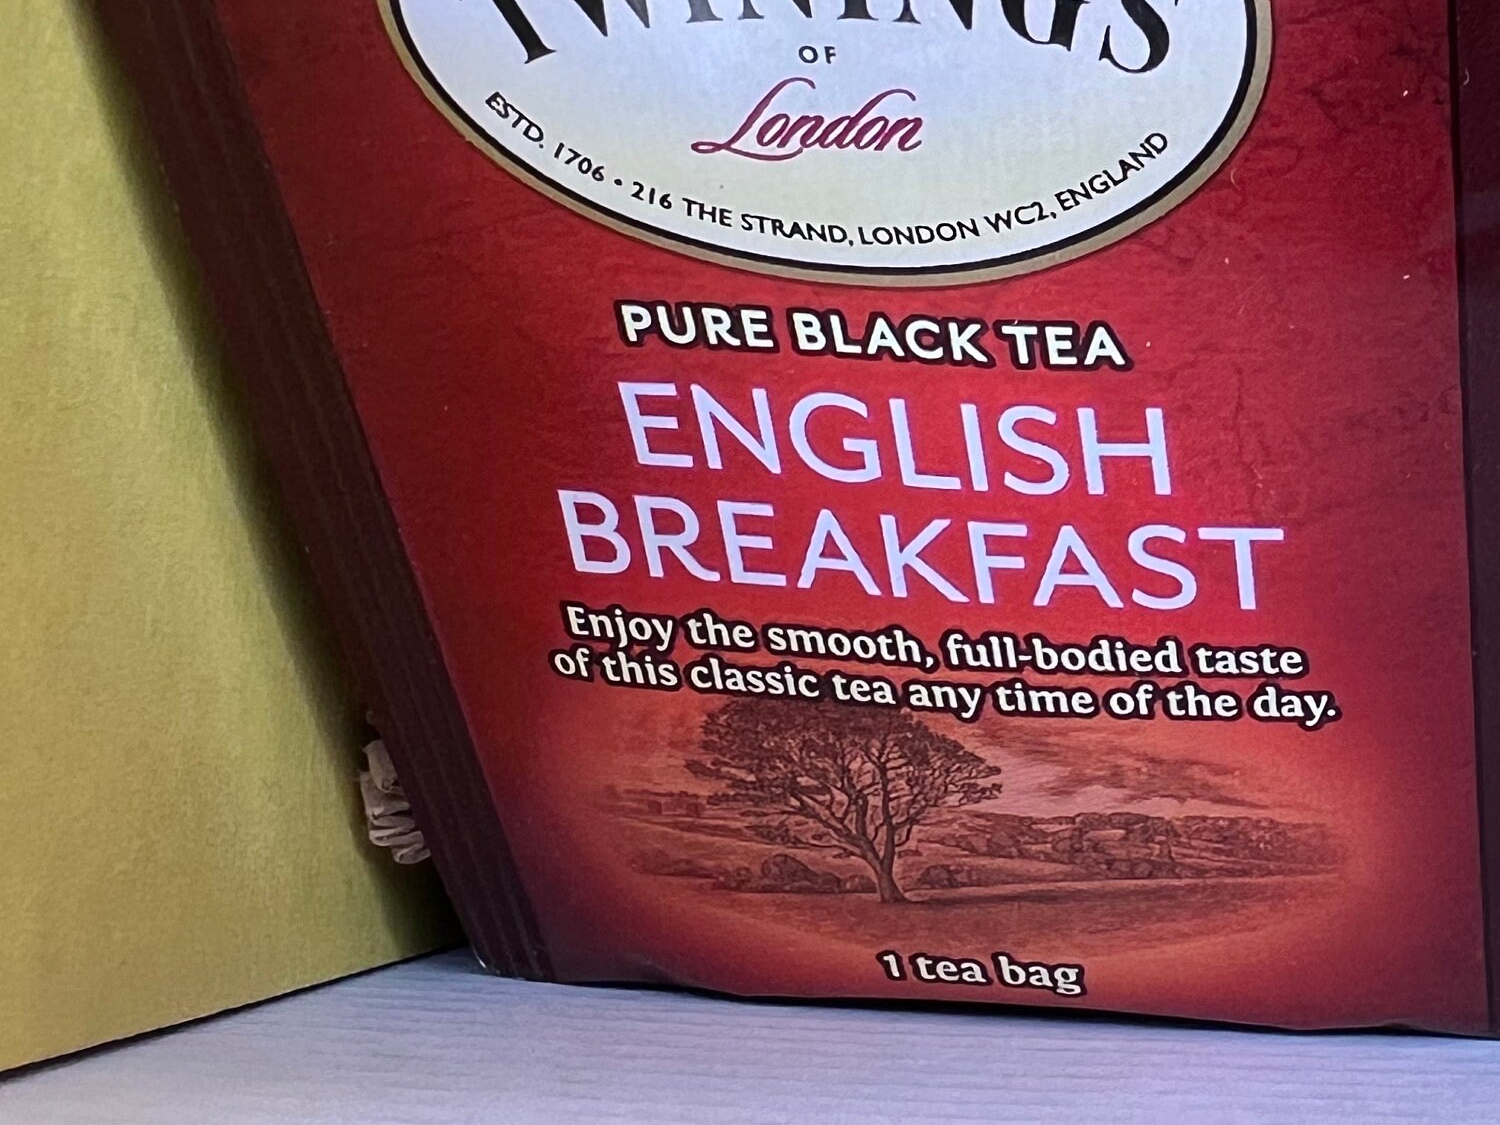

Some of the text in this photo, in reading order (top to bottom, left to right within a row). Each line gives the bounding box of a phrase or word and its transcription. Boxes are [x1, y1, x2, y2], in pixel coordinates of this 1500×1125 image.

[798, 44, 838, 66] OF
[691, 77, 923, 162] London
[485, 91, 1168, 247] ESTD. 1706 216 THE STRAND, LONDON WC2, ENGLAND
[621, 303, 1125, 367] PURE BLACK TEA
[618, 381, 1173, 497] ENGLISH
[557, 488, 1285, 612] BREAKFAST
[564, 606, 1304, 677] Enjoy the smooth, full-bodied taste
[555, 648, 1338, 725] of this classic tea any time of the day.
[883, 954, 1082, 995] 1 tea bag
